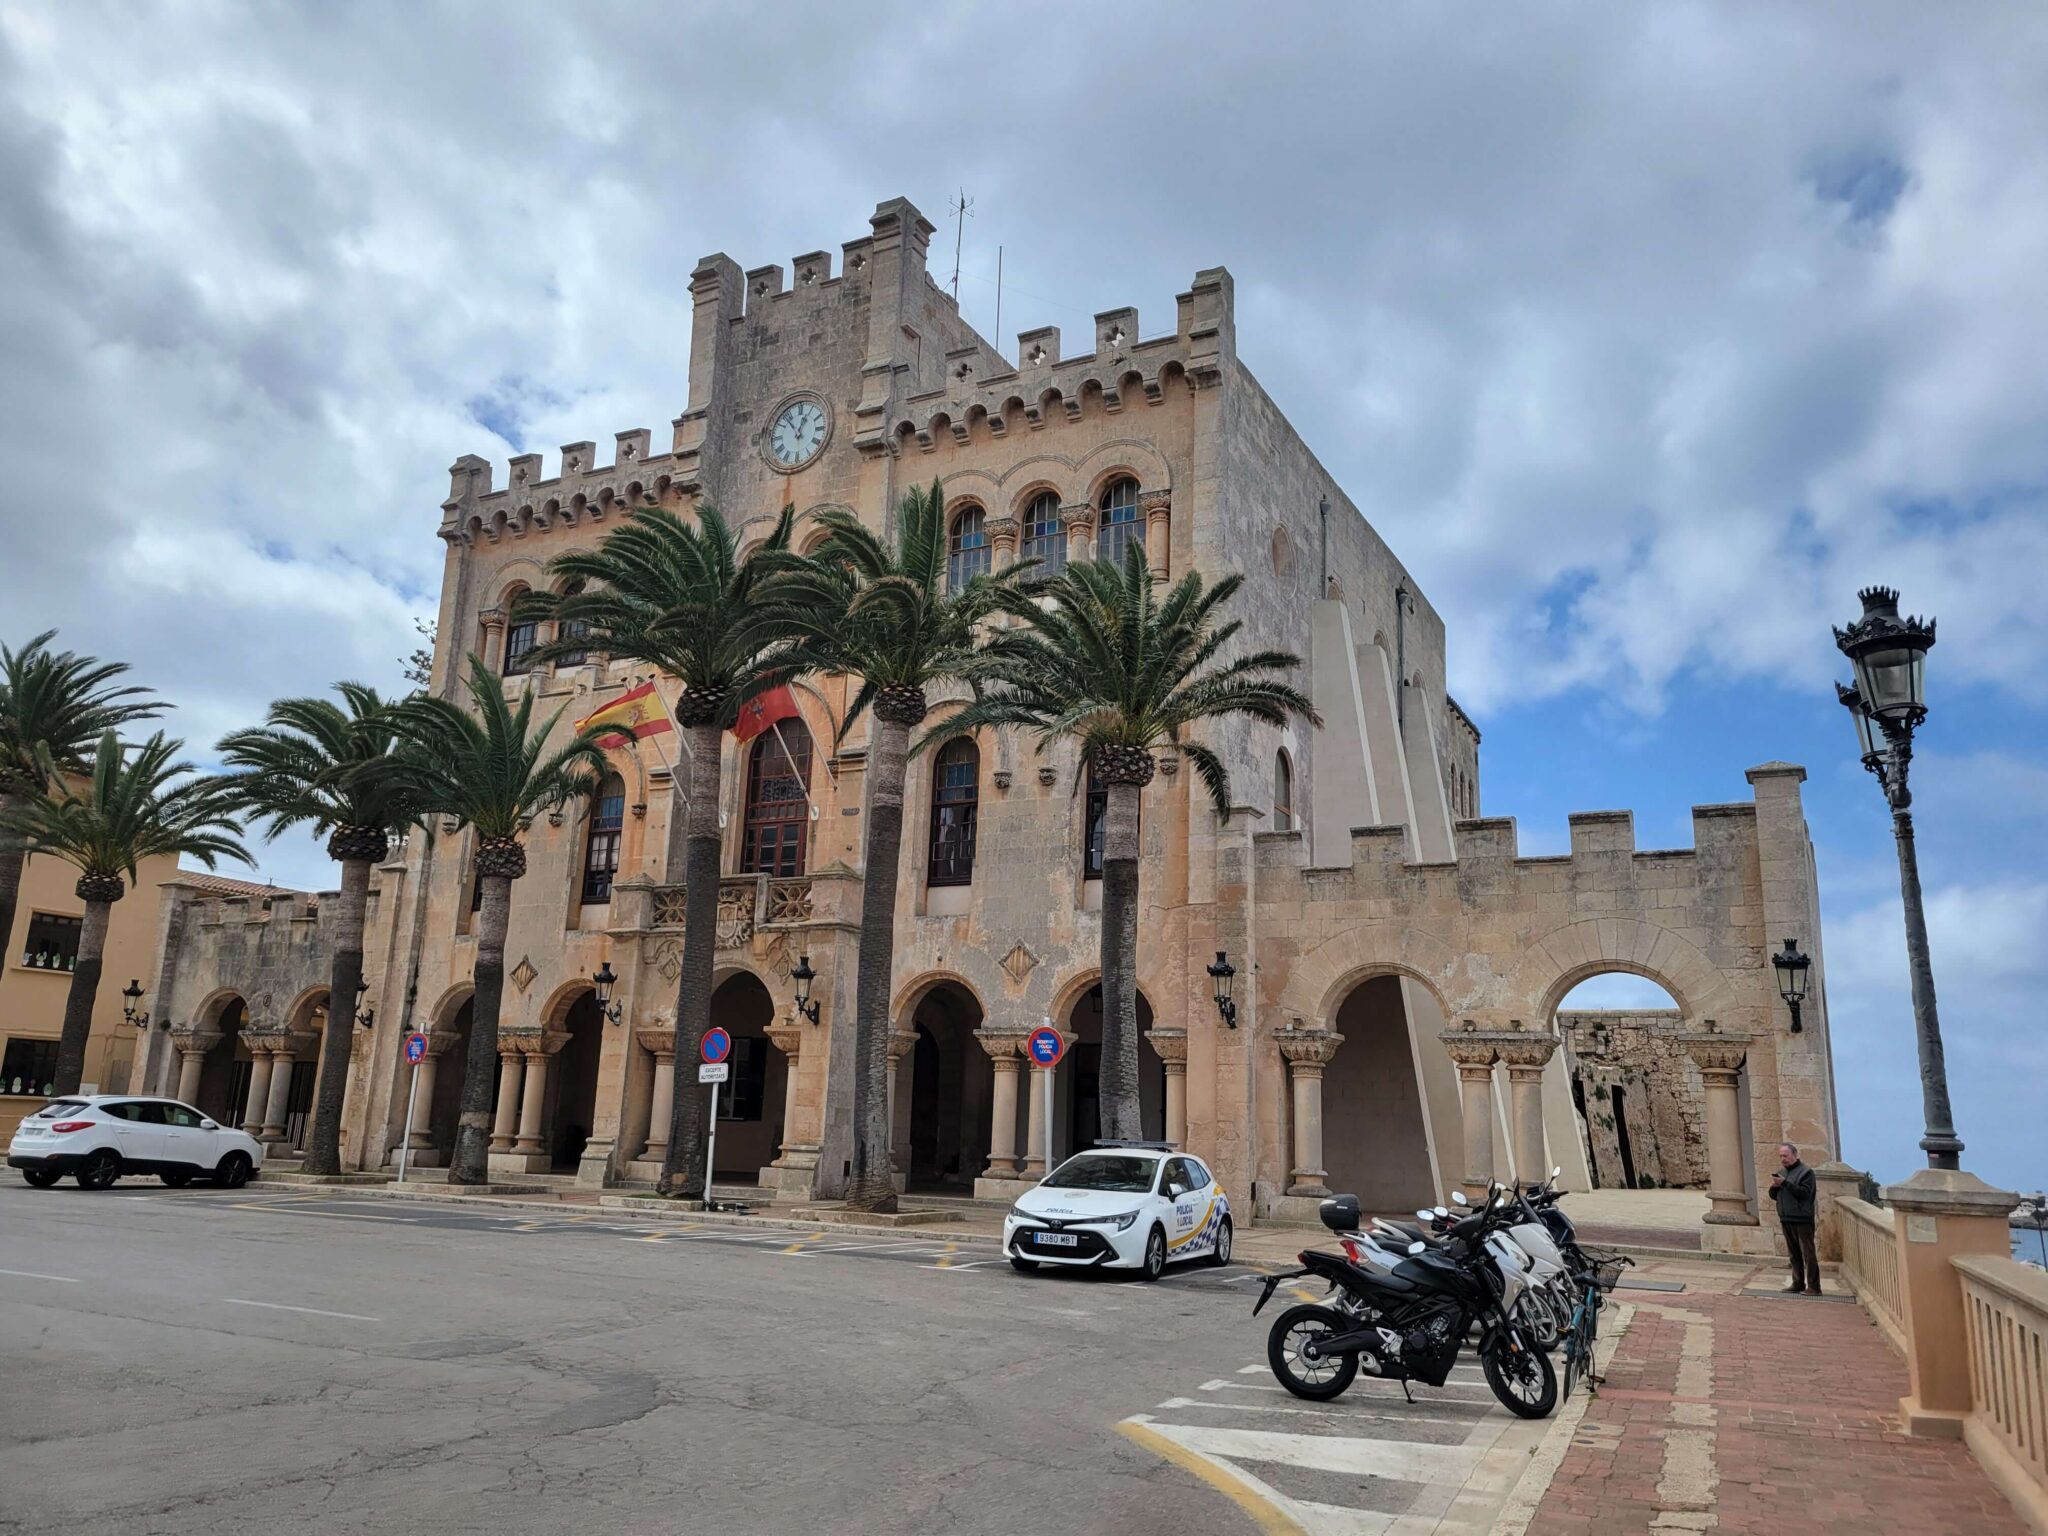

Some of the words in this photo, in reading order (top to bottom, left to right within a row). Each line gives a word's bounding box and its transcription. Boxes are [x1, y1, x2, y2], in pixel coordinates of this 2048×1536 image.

[1176, 1204, 1193, 1216] POLICIA
[1180, 1215, 1193, 1226] LOCAL
[1039, 1233, 1058, 1244] 9380
[1060, 1234, 1076, 1245] MBT
